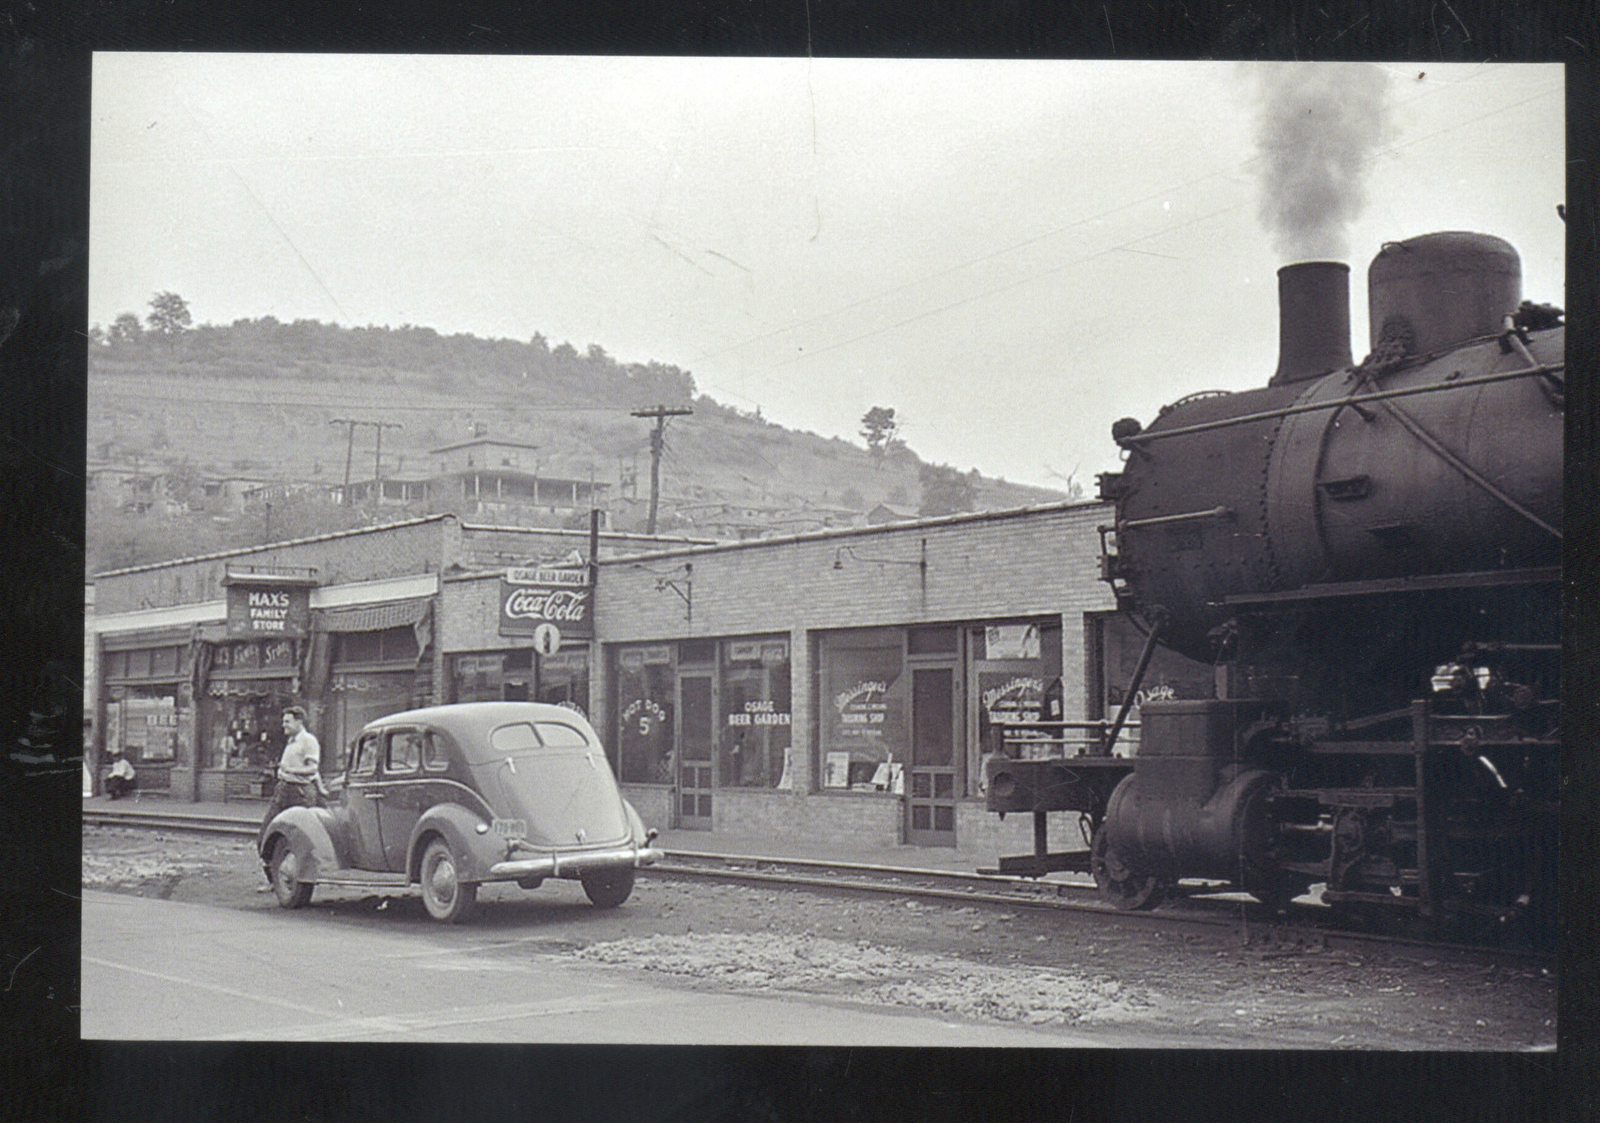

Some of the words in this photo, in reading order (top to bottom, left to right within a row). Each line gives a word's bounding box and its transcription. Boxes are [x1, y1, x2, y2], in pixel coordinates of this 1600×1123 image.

[249, 591, 289, 607] MAX'S
[505, 588, 588, 621] Coca-Cola
[250, 608, 287, 618] FAMILY
[253, 620, 284, 631] STORE
[744, 701, 774, 712] OSAGE
[728, 713, 751, 725] BEER
[754, 713, 791, 725] GARDEN
